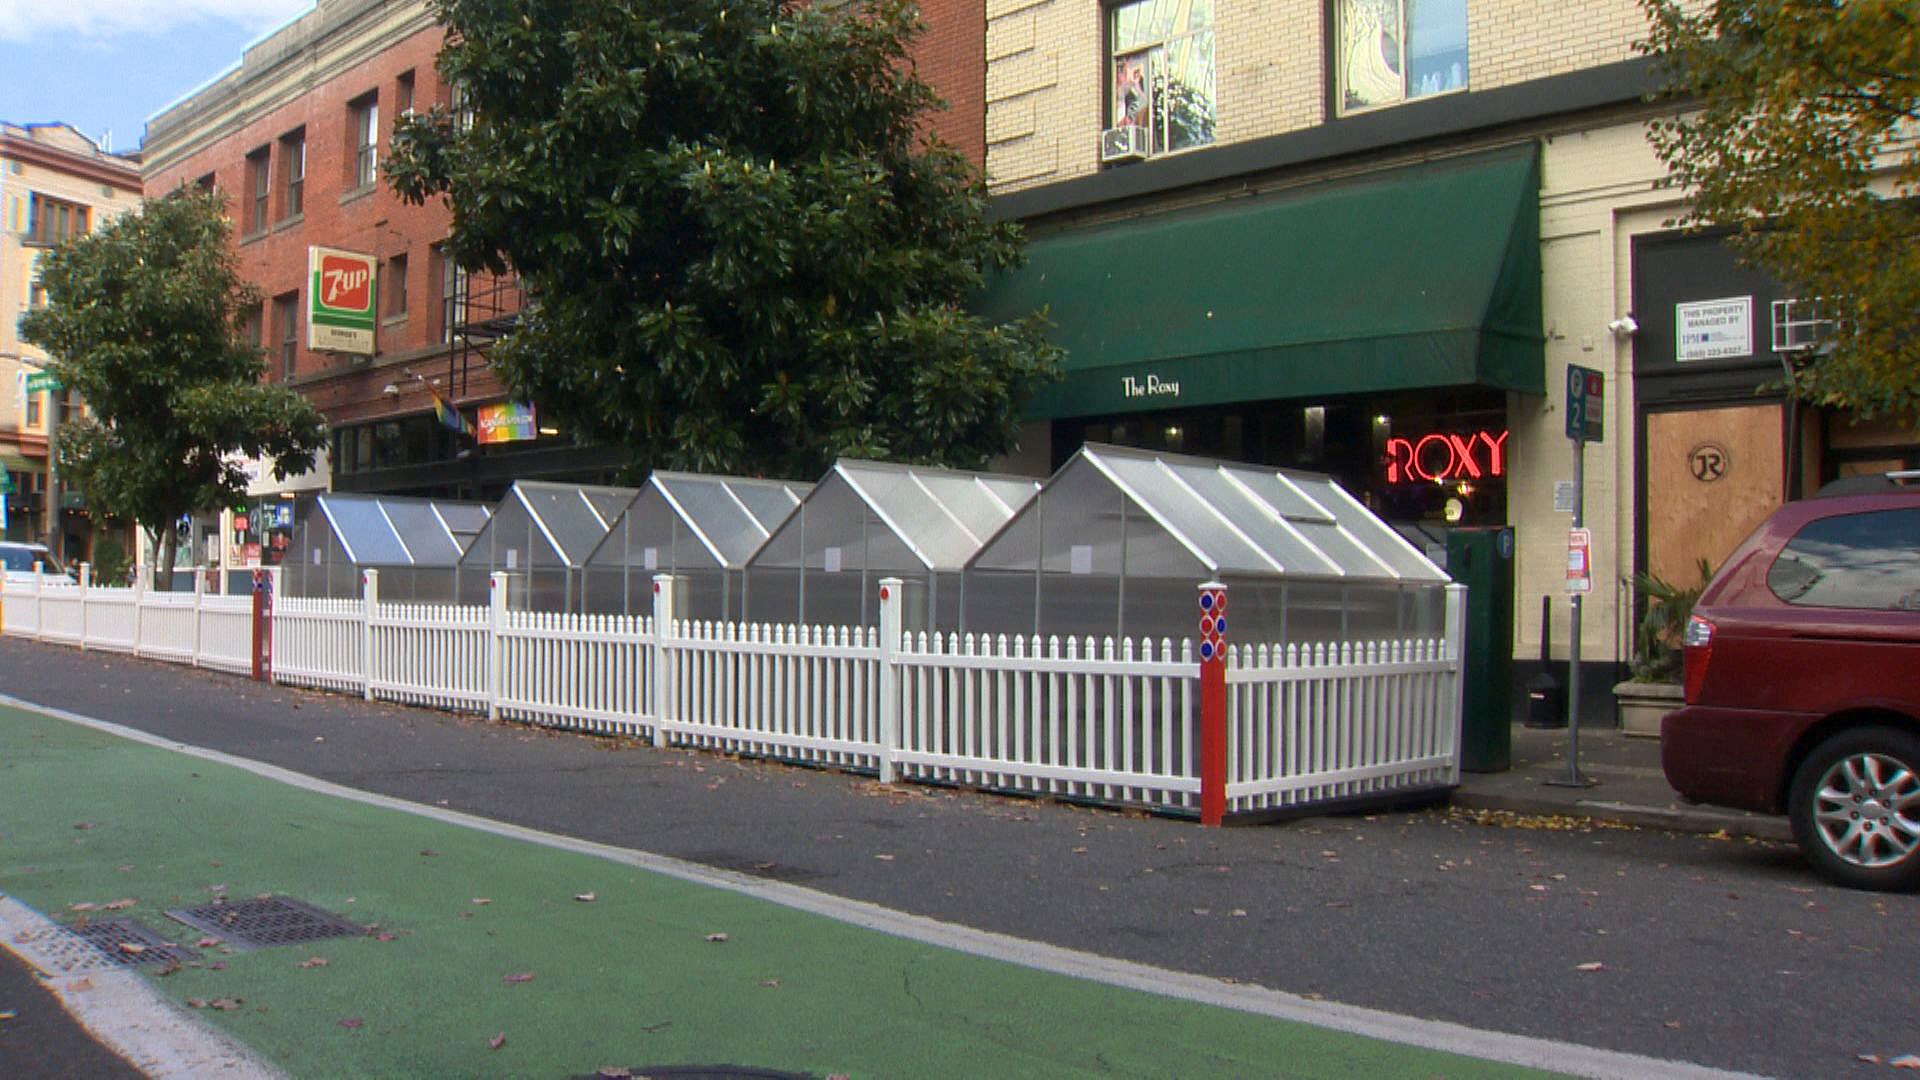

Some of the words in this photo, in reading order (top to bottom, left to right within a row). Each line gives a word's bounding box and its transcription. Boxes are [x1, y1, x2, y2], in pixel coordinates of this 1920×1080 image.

[323, 268, 367, 303] 7UP
[1683, 309, 1700, 318] THIS
[1702, 304, 1743, 315] PROPERTY
[1687, 317, 1727, 327] MANAGED
[1728, 314, 1739, 325] BY
[1121, 376, 1145, 398] The
[1147, 374, 1180, 397] Roxy
[1386, 430, 1509, 484] ROXY
